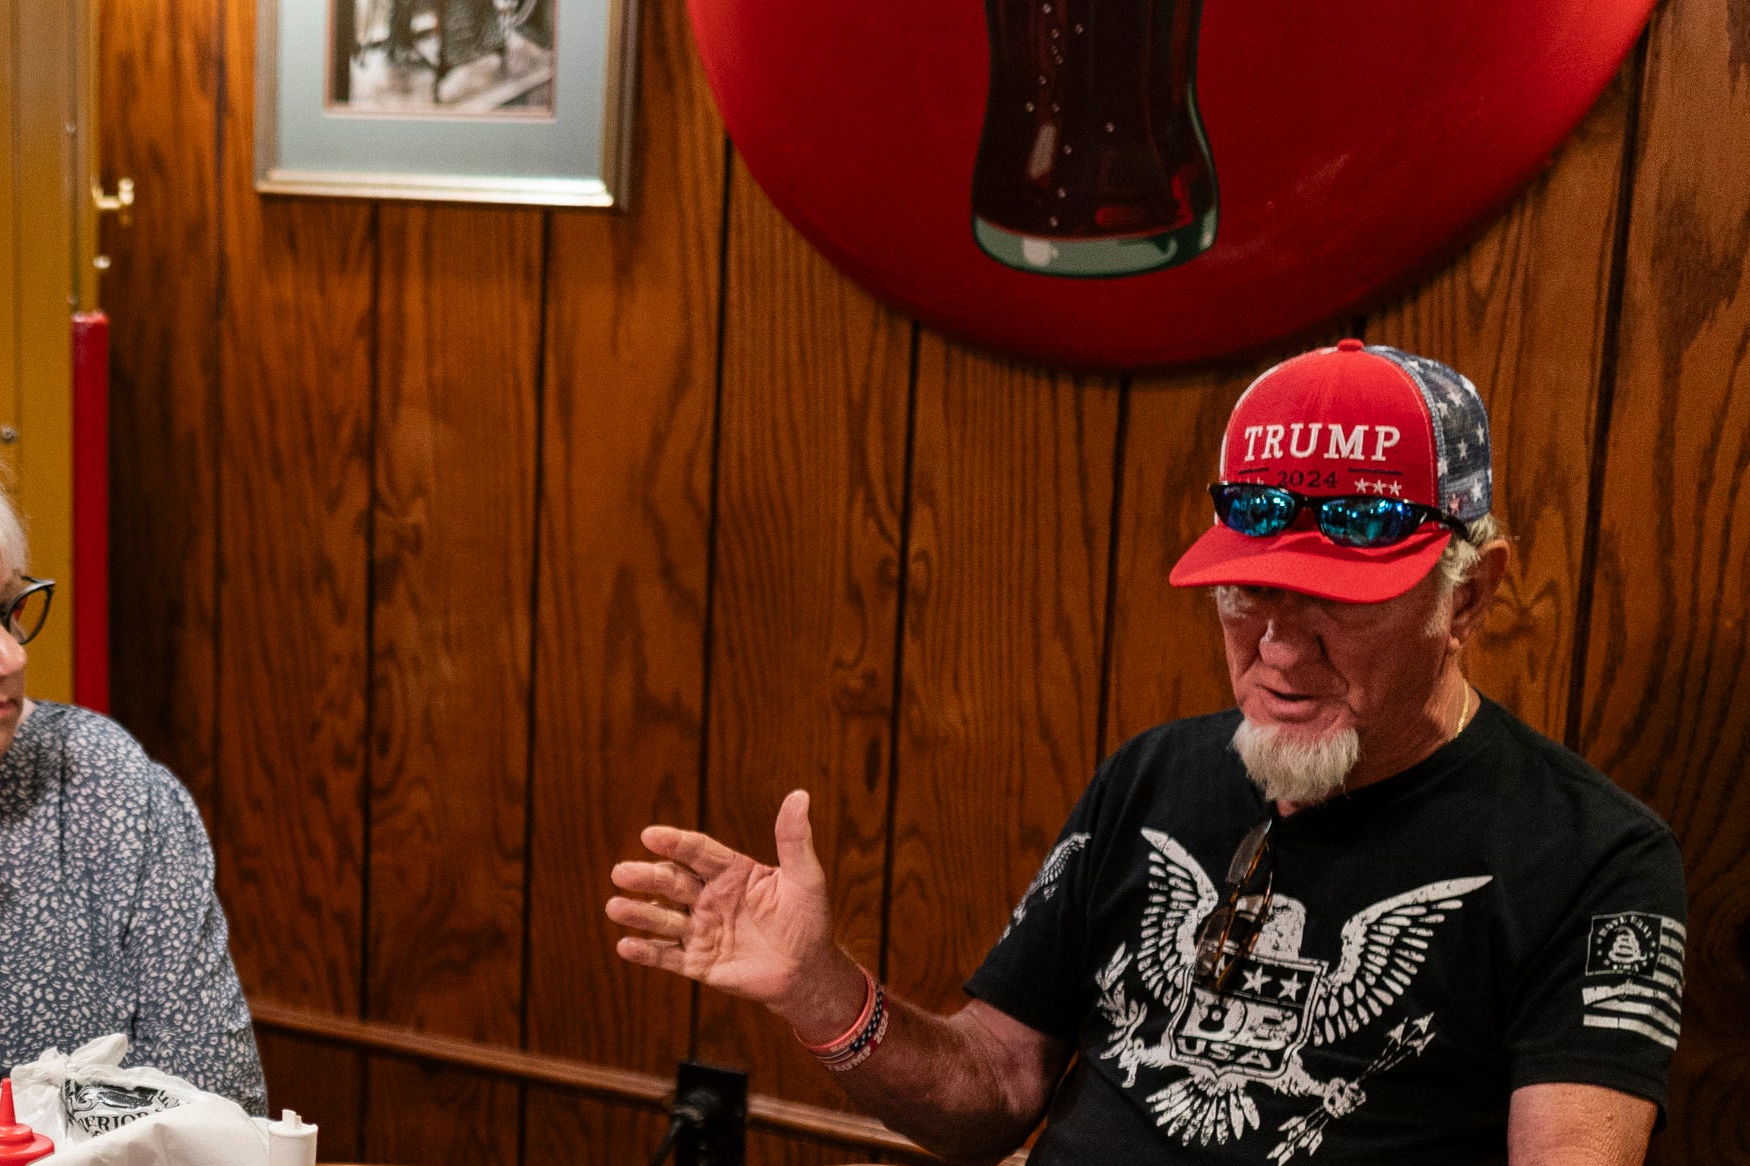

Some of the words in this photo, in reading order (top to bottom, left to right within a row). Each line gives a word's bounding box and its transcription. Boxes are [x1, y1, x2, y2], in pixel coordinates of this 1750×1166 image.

[1244, 422, 1401, 462] TRUMP
[1276, 469, 1338, 489] 2024
[1177, 1037, 1272, 1070] USA
